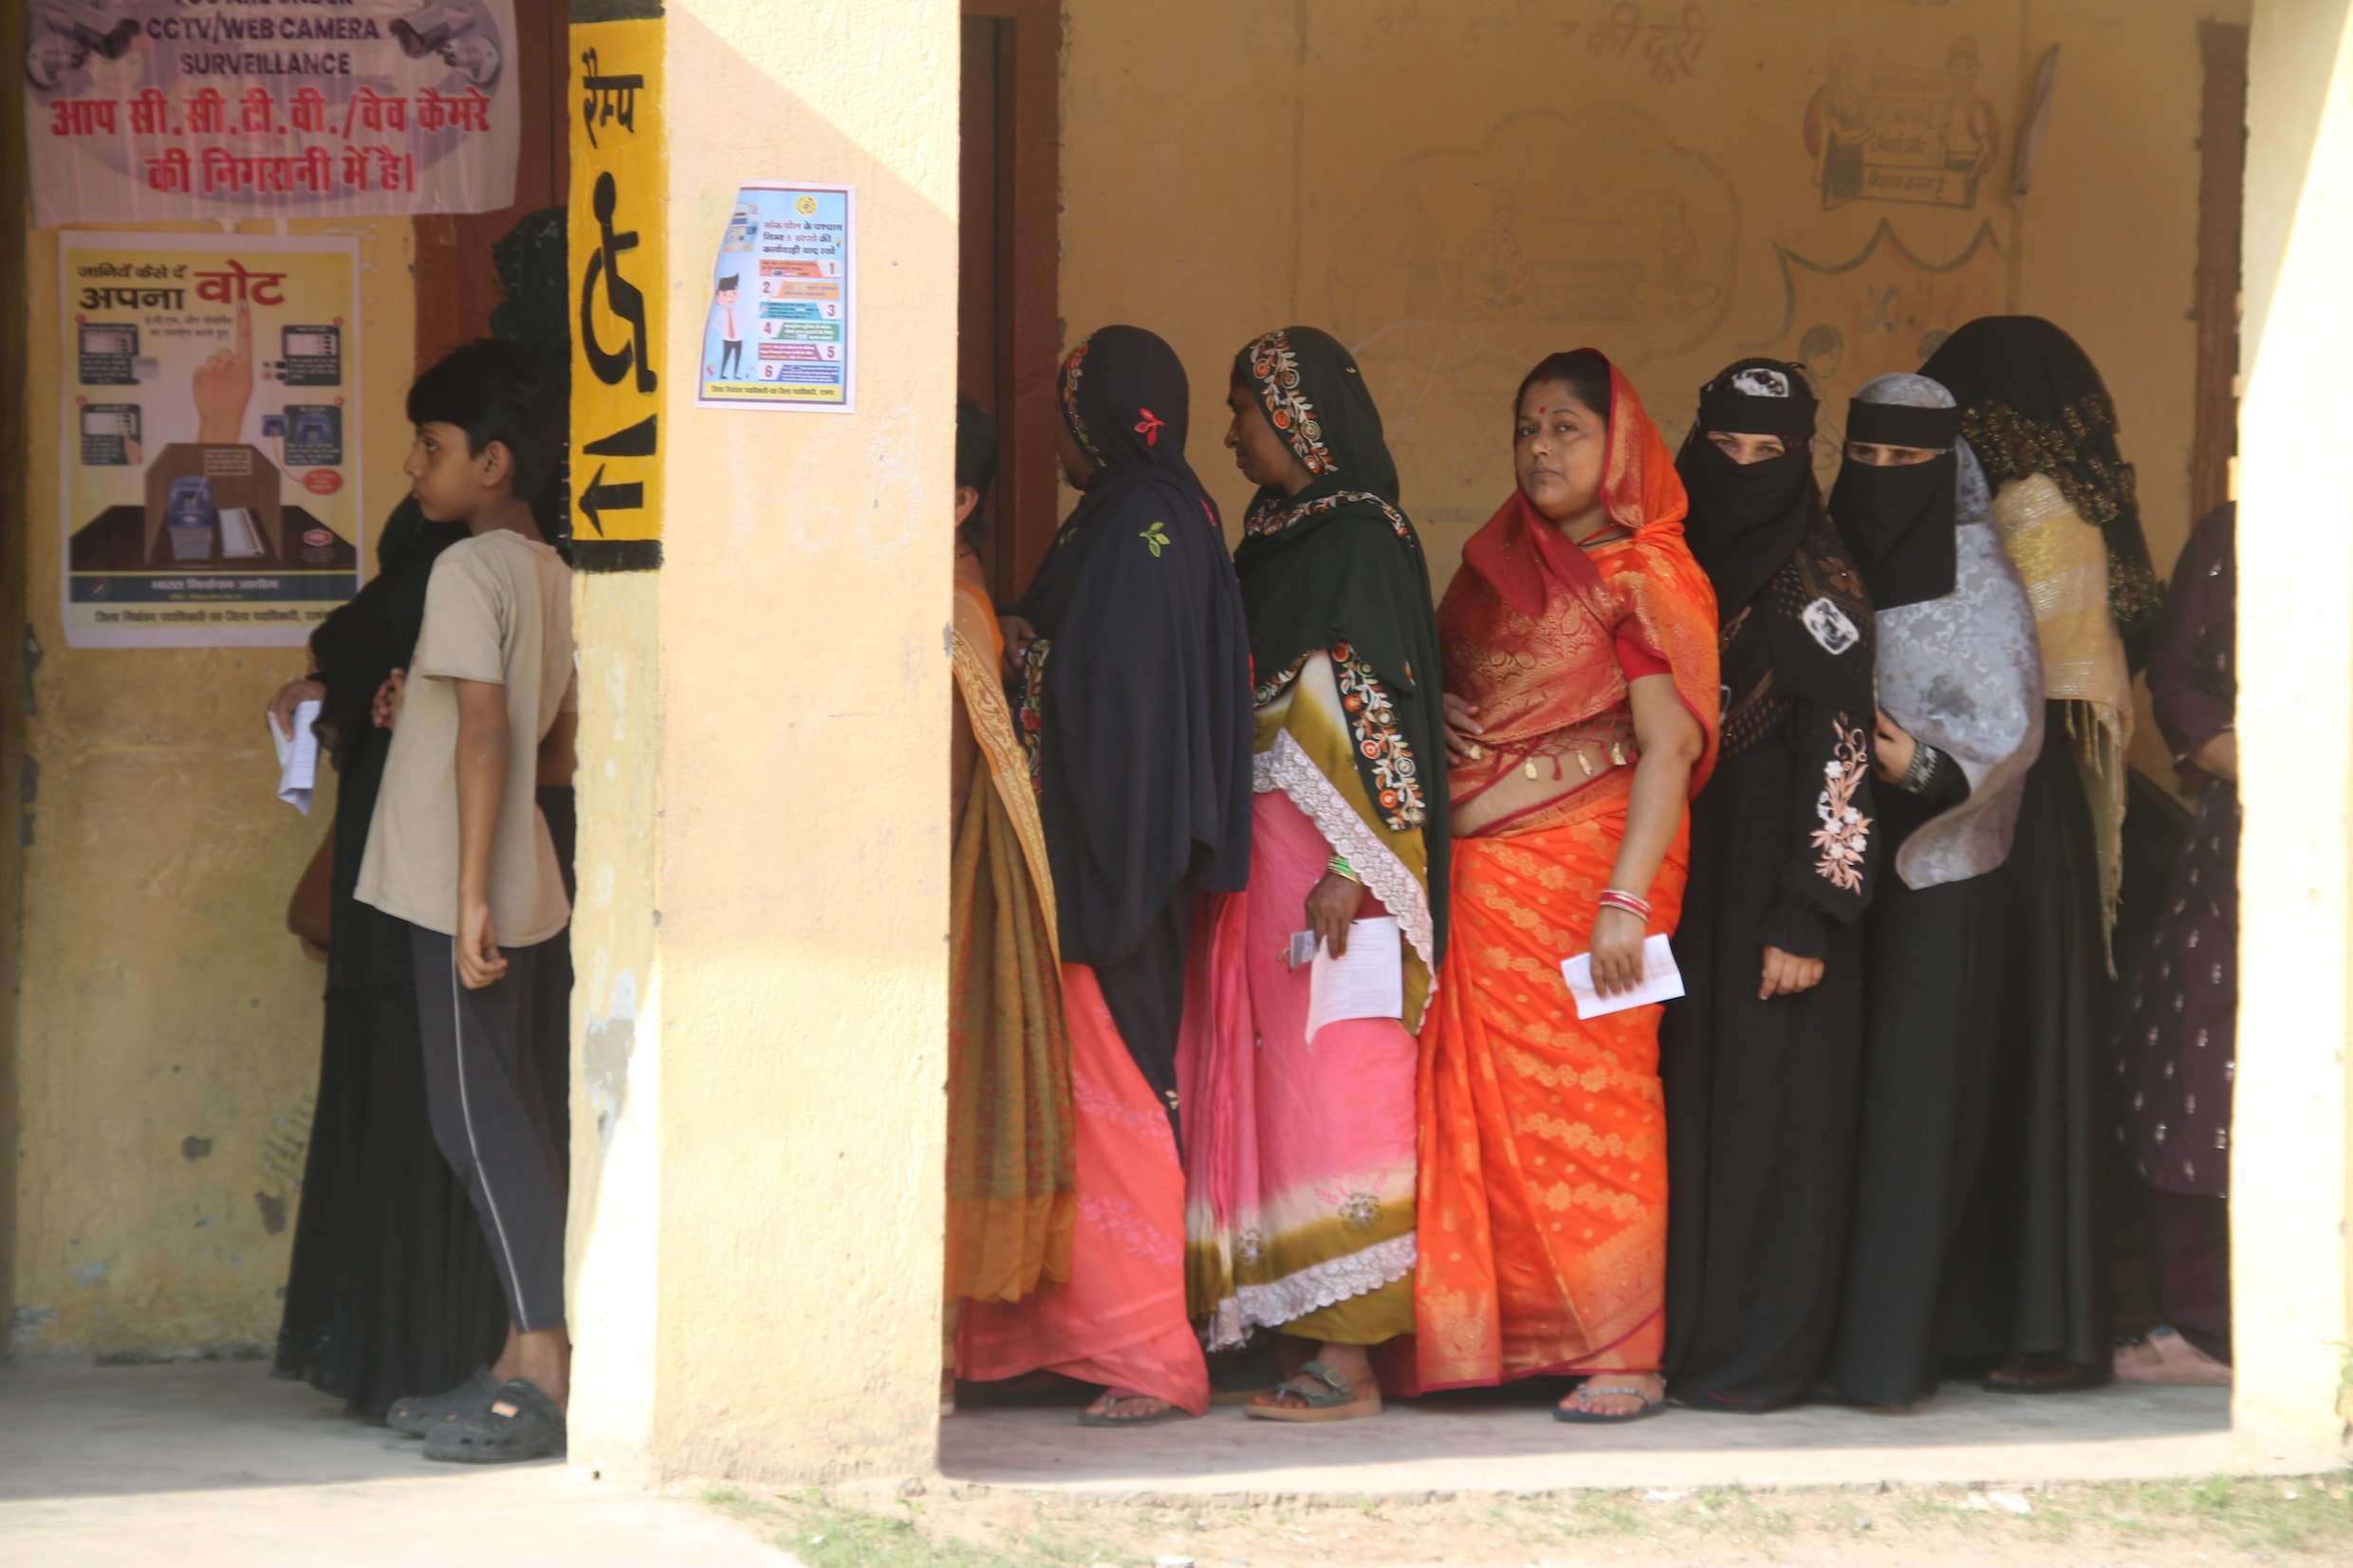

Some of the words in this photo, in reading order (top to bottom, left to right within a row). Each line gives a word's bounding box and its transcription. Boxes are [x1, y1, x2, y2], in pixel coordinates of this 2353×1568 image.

[146, 11, 274, 44] CCTV/WEB
[280, 17, 379, 39] CAMERA
[180, 52, 350, 75] SURVEILLANCE
[50, 98, 117, 136] आप
[416, 86, 491, 133] कैमरे
[145, 146, 191, 193] की
[201, 145, 333, 193] निगरानी
[342, 145, 370, 191] में
[828, 262, 835, 275] 1
[79, 286, 185, 310] अपना
[194, 258, 287, 305] वोट
[762, 281, 770, 293] 2
[827, 304, 835, 317] 3
[764, 322, 771, 334] 4
[827, 345, 835, 359] 5
[765, 365, 772, 378] 6
